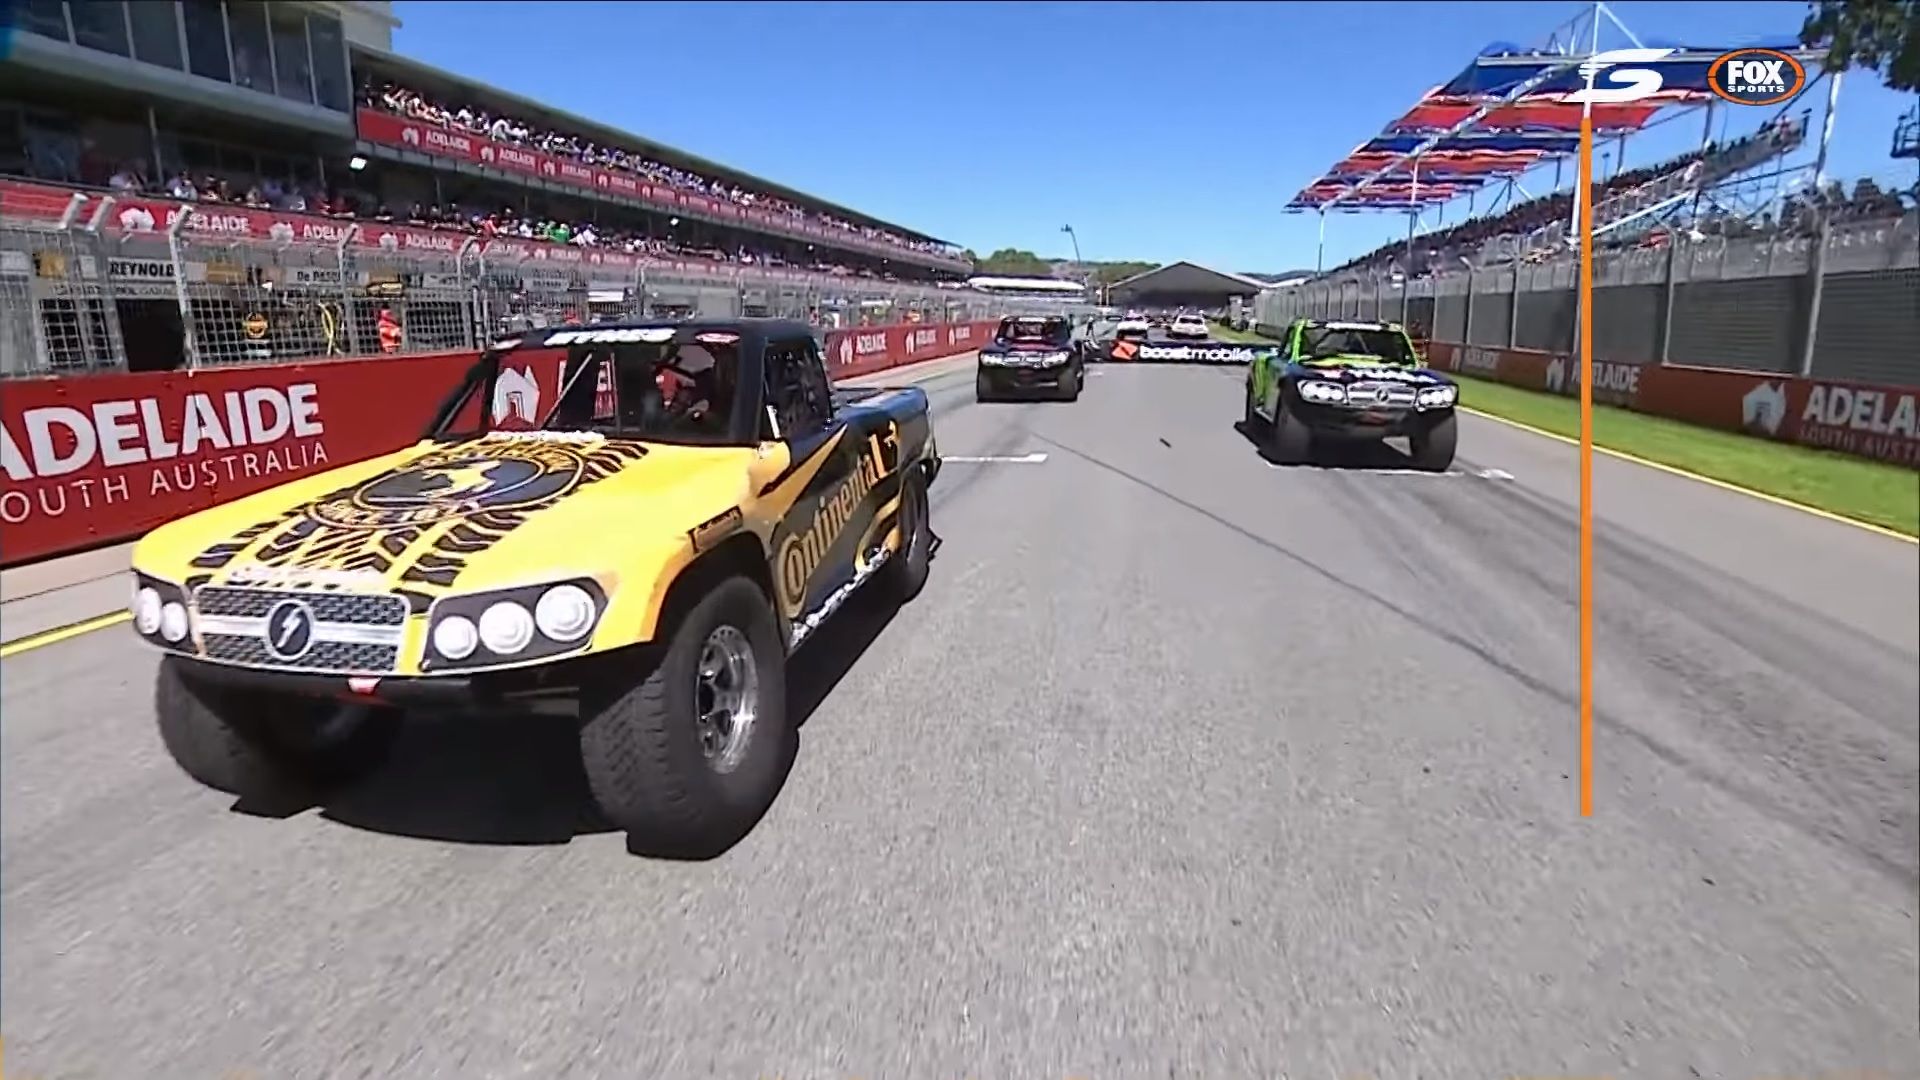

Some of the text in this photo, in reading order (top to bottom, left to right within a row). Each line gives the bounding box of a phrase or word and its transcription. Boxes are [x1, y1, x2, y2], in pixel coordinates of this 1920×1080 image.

[166, 210, 250, 232] AELAIDE
[303, 224, 365, 243] ADELAE
[1571, 360, 1640, 393] AELAIDE
[1801, 384, 1919, 440] ADELA
[150, 442, 329, 496] AUSTRALIA
